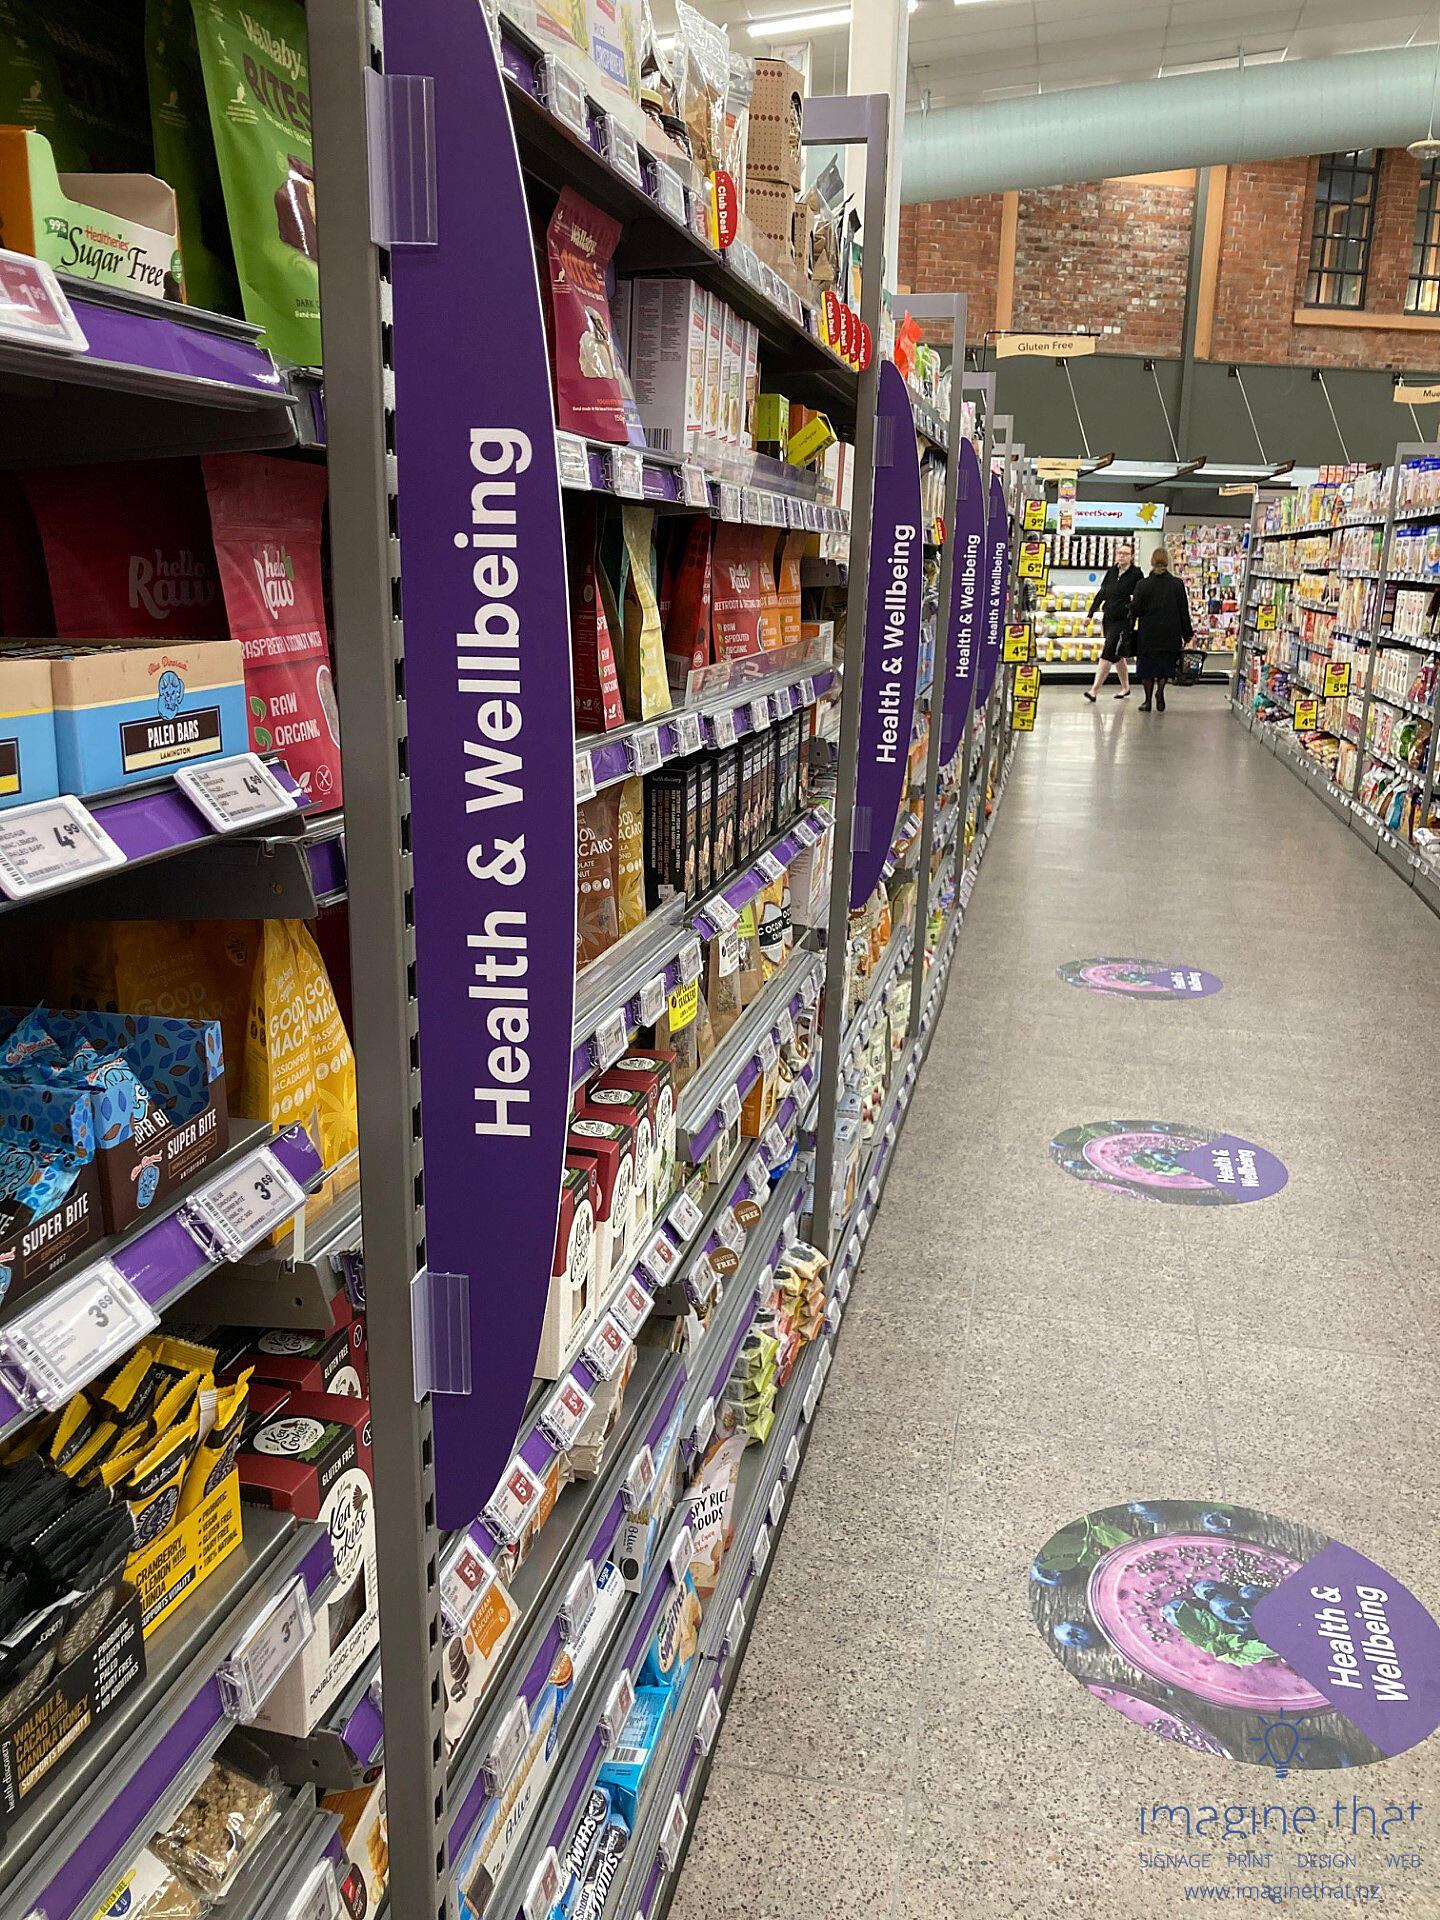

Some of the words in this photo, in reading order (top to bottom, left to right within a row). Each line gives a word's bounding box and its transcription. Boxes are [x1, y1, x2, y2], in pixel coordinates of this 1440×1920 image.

[239, 10, 301, 80] Wallaby
[718, 186, 727, 210] Club
[719, 211, 729, 233] Deal
[61, 227, 123, 280] Sugar
[127, 247, 163, 286] Free
[1018, 343, 1049, 352] Gluten
[1052, 341, 1073, 350] Free
[883, 524, 916, 650] Wellbeing
[960, 534, 981, 611] Wellbeing
[990, 542, 1006, 598] Wellbeing
[453, 426, 533, 814] Wellbeing
[960, 613, 973, 625] &
[990, 599, 999, 607] &
[988, 612, 999, 645] Health
[882, 657, 902, 675] &
[956, 628, 972, 678] Health
[270, 692, 297, 717] RAW
[876, 682, 901, 763] Health
[148, 726, 175, 748] PALEO
[177, 720, 199, 743] BARS
[275, 719, 320, 746] ORGANIC
[160, 747, 191, 760] LAMINGTON
[579, 828, 595, 842] OD
[619, 811, 633, 827] OOD
[466, 838, 526, 885] &
[270, 995, 305, 1037] GOOD
[466, 911, 531, 1137] Health
[153, 1109, 169, 1128] BI
[168, 1125, 197, 1159] SUPER
[198, 1108, 217, 1137] BITE
[1213, 1158, 1236, 1183] Health
[1236, 1149, 1260, 1187] Wellbeing
[0, 1213, 14, 1236] TE
[22, 1213, 62, 1256] SUPER
[66, 1192, 89, 1226] BITE
[741, 1210, 760, 1222] FREE
[716, 1259, 737, 1270] FREE
[338, 1344, 349, 1362] FREE
[265, 1427, 290, 1443] Kea
[322, 1459, 341, 1486] GLUTEN
[342, 1444, 355, 1465] FREE
[221, 1508, 233, 1527] FREE
[330, 1496, 351, 1539] Kea
[691, 1497, 707, 1519] SPY
[694, 1507, 723, 1530] OUDS
[336, 1510, 367, 1566] okies
[136, 1534, 182, 1587] CRANBERRY
[144, 1562, 171, 1594] LEMON
[142, 1581, 166, 1612] UINOA
[475, 1595, 492, 1622] CREAM
[1310, 1586, 1341, 1602] &
[98, 1618, 129, 1658] PROBIOTIC
[474, 1606, 495, 1638] BISCUITS
[99, 1640, 121, 1670] GLUTEN
[120, 1624, 135, 1648] FREE
[1315, 1607, 1363, 1689] Health
[1356, 1585, 1409, 1701] Wellbeing
[99, 1657, 119, 1685] PALEO
[100, 1672, 119, 1697] DAIRY
[118, 1654, 134, 1678] FREE
[310, 1670, 332, 1704] DOUBLE
[333, 1649, 349, 1673] CHOC
[350, 1632, 362, 1652] CHIP
[101, 1696, 111, 1711] NO
[111, 1662, 139, 1703] ADDITIVES
[13, 1697, 55, 1743] WALNUT
[56, 1689, 65, 1706] &
[16, 1720, 49, 1763] CACAO
[50, 1700, 69, 1728] WITH
[17, 1731, 58, 1780] MANUKA
[59, 1693, 89, 1737] HONEY
[21, 1747, 57, 1791] SUPPORTS
[57, 1714, 90, 1753] IMMUNITY
[2, 1740, 11, 1783] discovery
[6, 1781, 15, 1815] health
